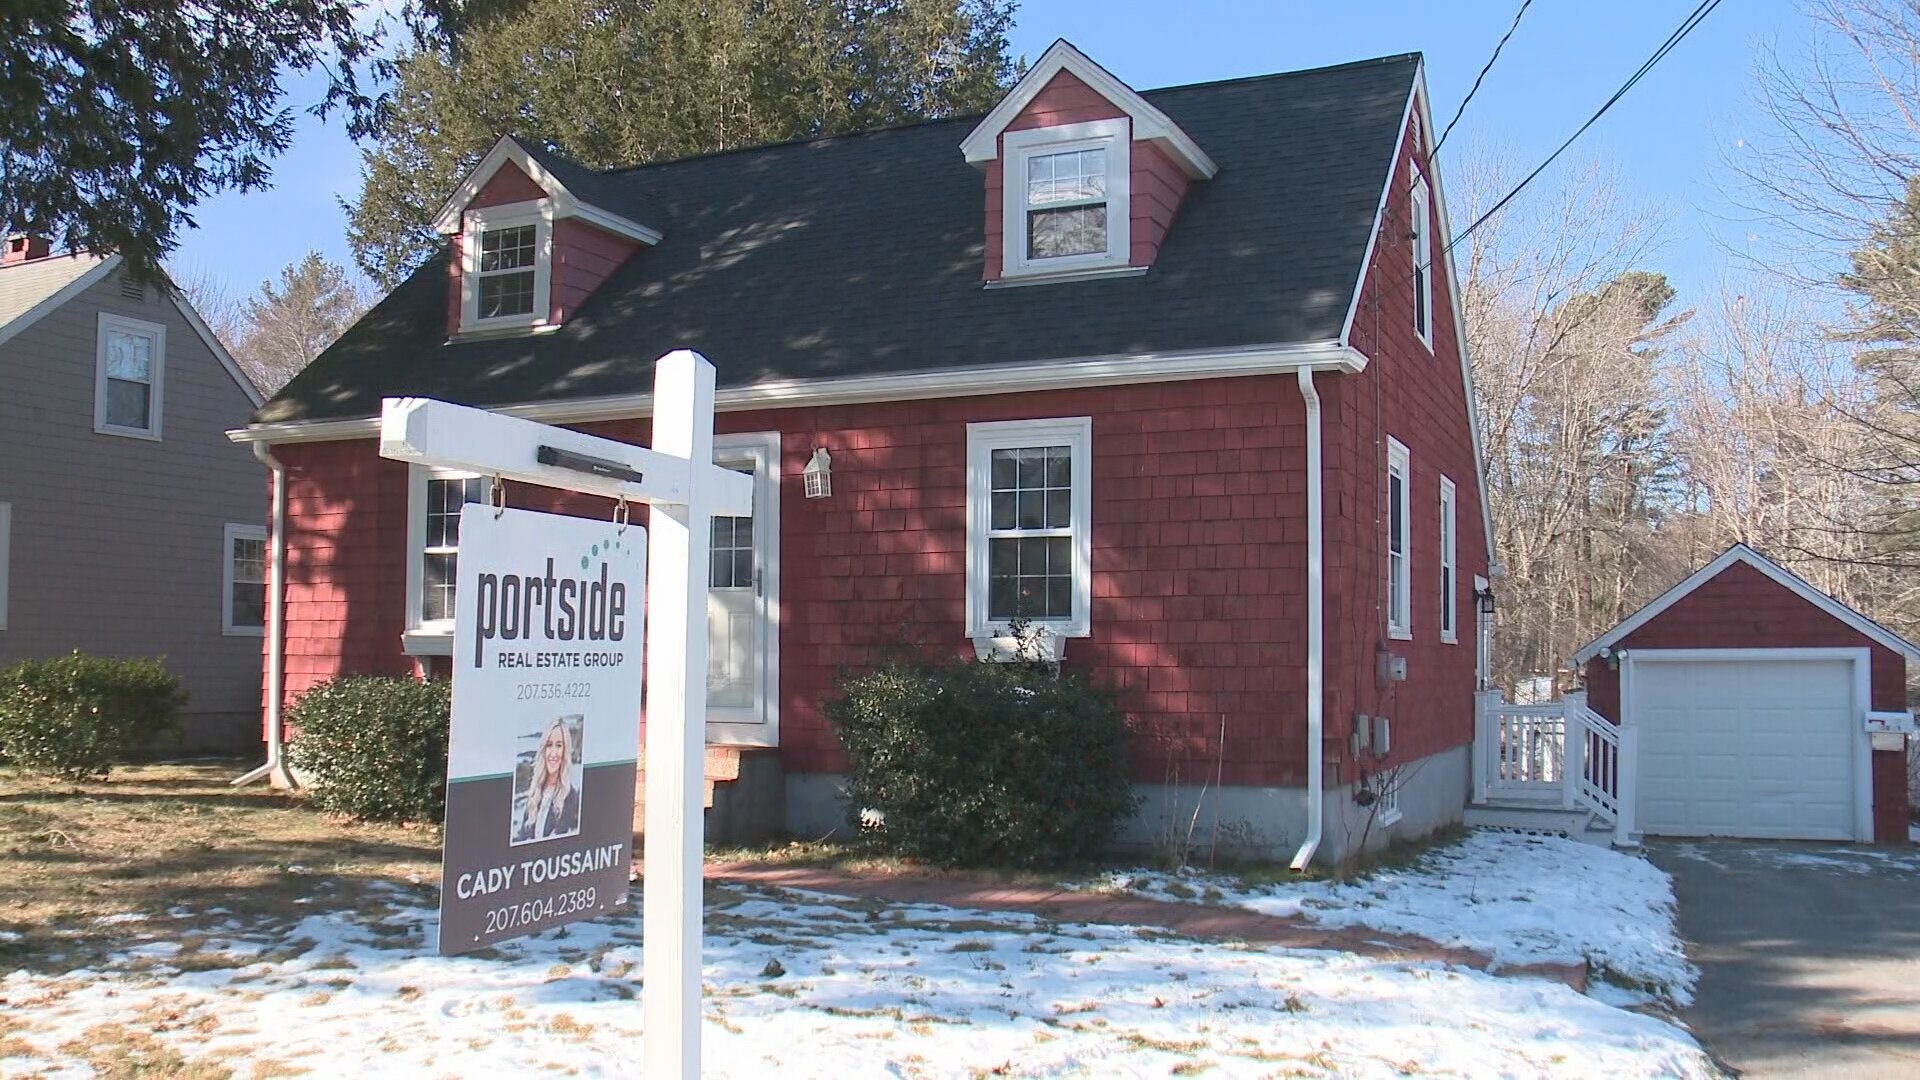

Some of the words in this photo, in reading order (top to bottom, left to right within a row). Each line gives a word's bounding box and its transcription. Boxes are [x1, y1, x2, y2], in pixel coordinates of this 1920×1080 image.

[475, 557, 626, 668] portside
[498, 652, 533, 668] REAL
[536, 652, 580, 668] ESTATE
[583, 652, 624, 667] GROUP
[517, 682, 591, 700] 207.536.4222
[456, 864, 516, 899] CADY
[521, 843, 623, 885] TOUSSAINT
[485, 886, 596, 935] 207.604.2389
